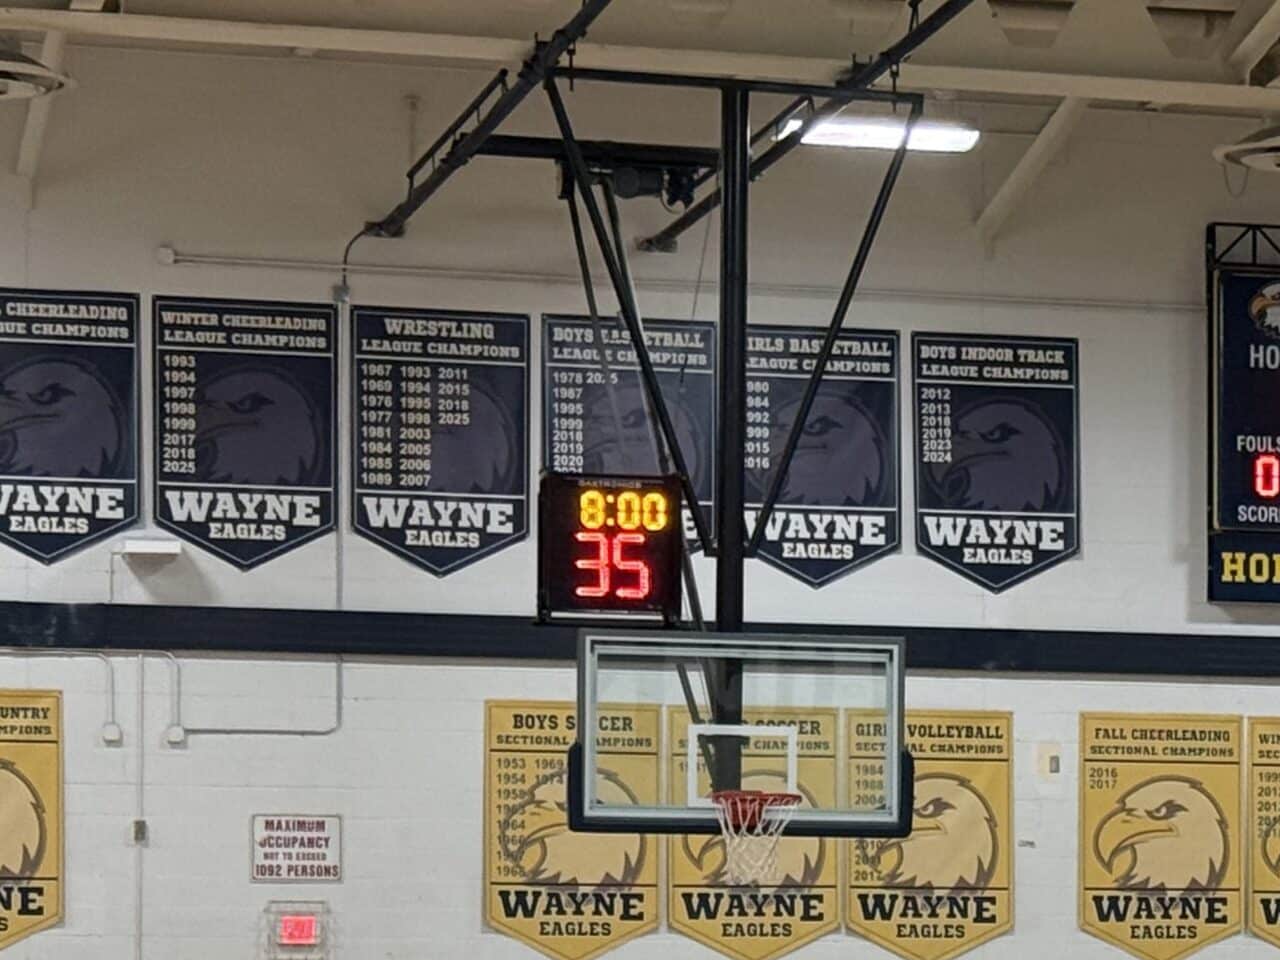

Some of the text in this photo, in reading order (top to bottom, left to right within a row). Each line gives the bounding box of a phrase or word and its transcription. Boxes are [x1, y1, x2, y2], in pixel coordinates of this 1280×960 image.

[6, 302, 128, 320] CHEERLEADING
[162, 312, 326, 331] WINTER CHEERLEADING
[385, 319, 494, 339] WRESTLING
[32, 323, 129, 338] CHAMPIONS
[553, 328, 593, 343] BOYS
[165, 330, 326, 348] LEAGUE CHAMPIONS
[362, 340, 519, 357] LEAGUE CHAMPIONS
[920, 346, 1064, 363] BOYS INDOOR TRACK
[164, 355, 195, 367] 1993
[922, 365, 1068, 380] LEAGUE CHAMPIONS
[553, 388, 583, 399] 1987
[438, 413, 470, 425] 2025
[164, 434, 195, 445] 2017
[921, 452, 951, 462] 2024
[1255, 455, 1280, 497] 0
[165, 491, 320, 526] WAYNE
[363, 498, 513, 533] WAYNE
[580, 490, 667, 531] 8:00
[10, 516, 88, 533] EAGLES
[209, 523, 285, 540] EAGLES
[405, 530, 480, 547] EAGLES
[924, 517, 1064, 550] WAYNE
[783, 543, 853, 559] EAGLES
[963, 549, 1032, 564] EAGLES
[575, 532, 649, 599] 35
[512, 714, 632, 731] BOYS SCER
[907, 725, 1003, 738] VOLLEYBALL
[1095, 729, 1230, 742] FALL CHEERLEADING
[496, 735, 569, 745] SECTIONAL
[930, 744, 1003, 754] CHAMPIONS
[1090, 746, 1234, 757] SECTIONAL CHAMPIONS
[496, 759, 525, 768] 1953
[1089, 768, 1117, 778] 2016
[265, 820, 325, 832] MAXIMUM
[256, 864, 338, 876] 1092 PERSONS
[499, 890, 644, 922] WAYNE
[682, 893, 824, 922] WAYNE
[858, 894, 996, 924] WAYNE
[1092, 896, 1227, 924] WAYNE
[540, 921, 612, 937] EAGLES
[721, 923, 792, 938] EAGLES
[896, 924, 965, 939] EAGLES
[1130, 925, 1197, 939] EAGLES
